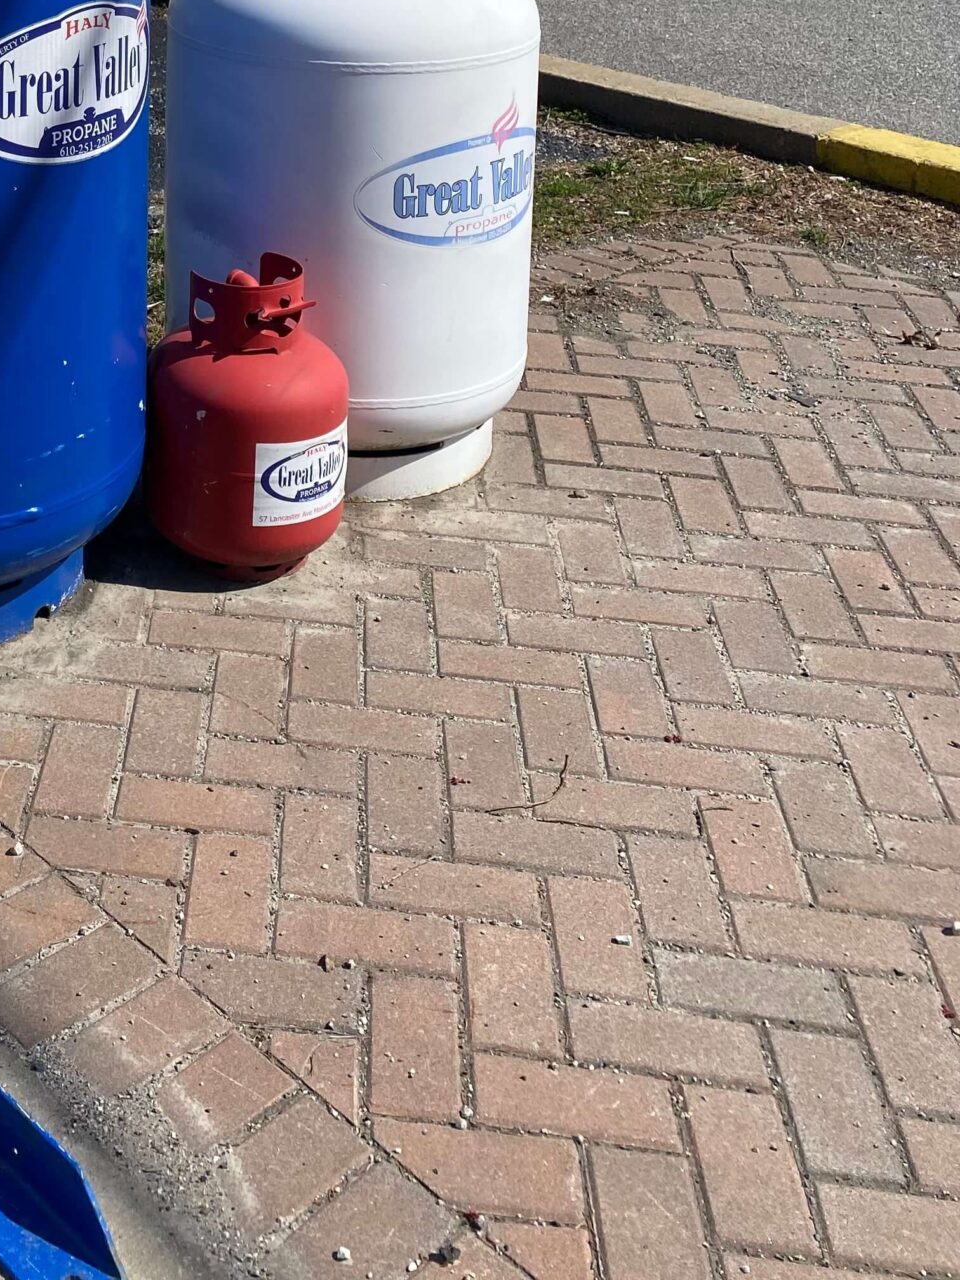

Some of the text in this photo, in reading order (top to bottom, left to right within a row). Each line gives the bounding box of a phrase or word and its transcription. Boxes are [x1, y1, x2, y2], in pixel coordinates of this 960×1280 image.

[19, 33, 30, 43] OF
[65, 11, 113, 40] HALY
[51, 114, 117, 147] PROPANE
[393, 166, 483, 219] Great
[455, 211, 513, 243] propane
[306, 445, 327, 457] HALY
[278, 463, 314, 488] Great
[300, 483, 329, 498] PROPANE
[269, 513, 300, 522] Lancaster
